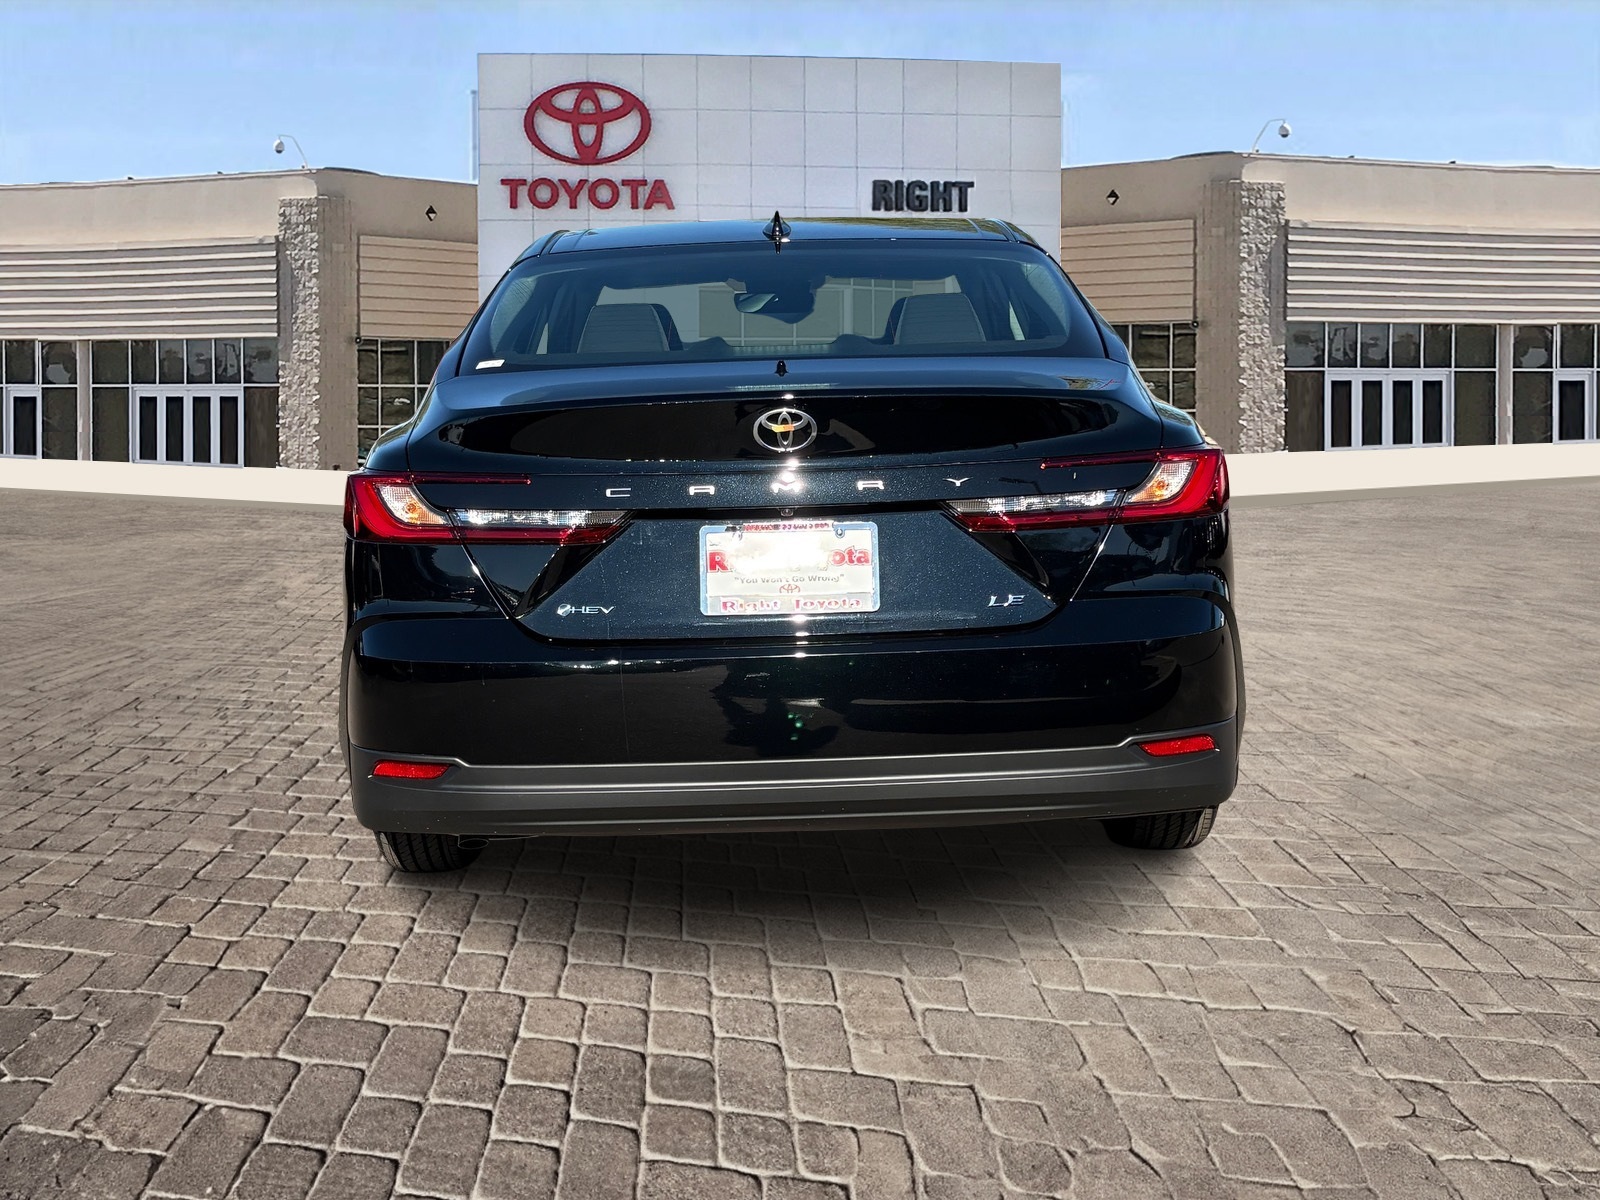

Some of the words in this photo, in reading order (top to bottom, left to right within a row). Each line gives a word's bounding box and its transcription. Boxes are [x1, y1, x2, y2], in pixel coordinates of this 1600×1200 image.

[500, 178, 675, 210] TOYOTA
[871, 179, 976, 213] RIGHT
[605, 475, 970, 498] CAMRY
[792, 575, 806, 584] Go
[721, 598, 781, 613] Right
[794, 598, 861, 611] Toyota
[988, 594, 1026, 607] LE
[570, 606, 616, 614] HEV
